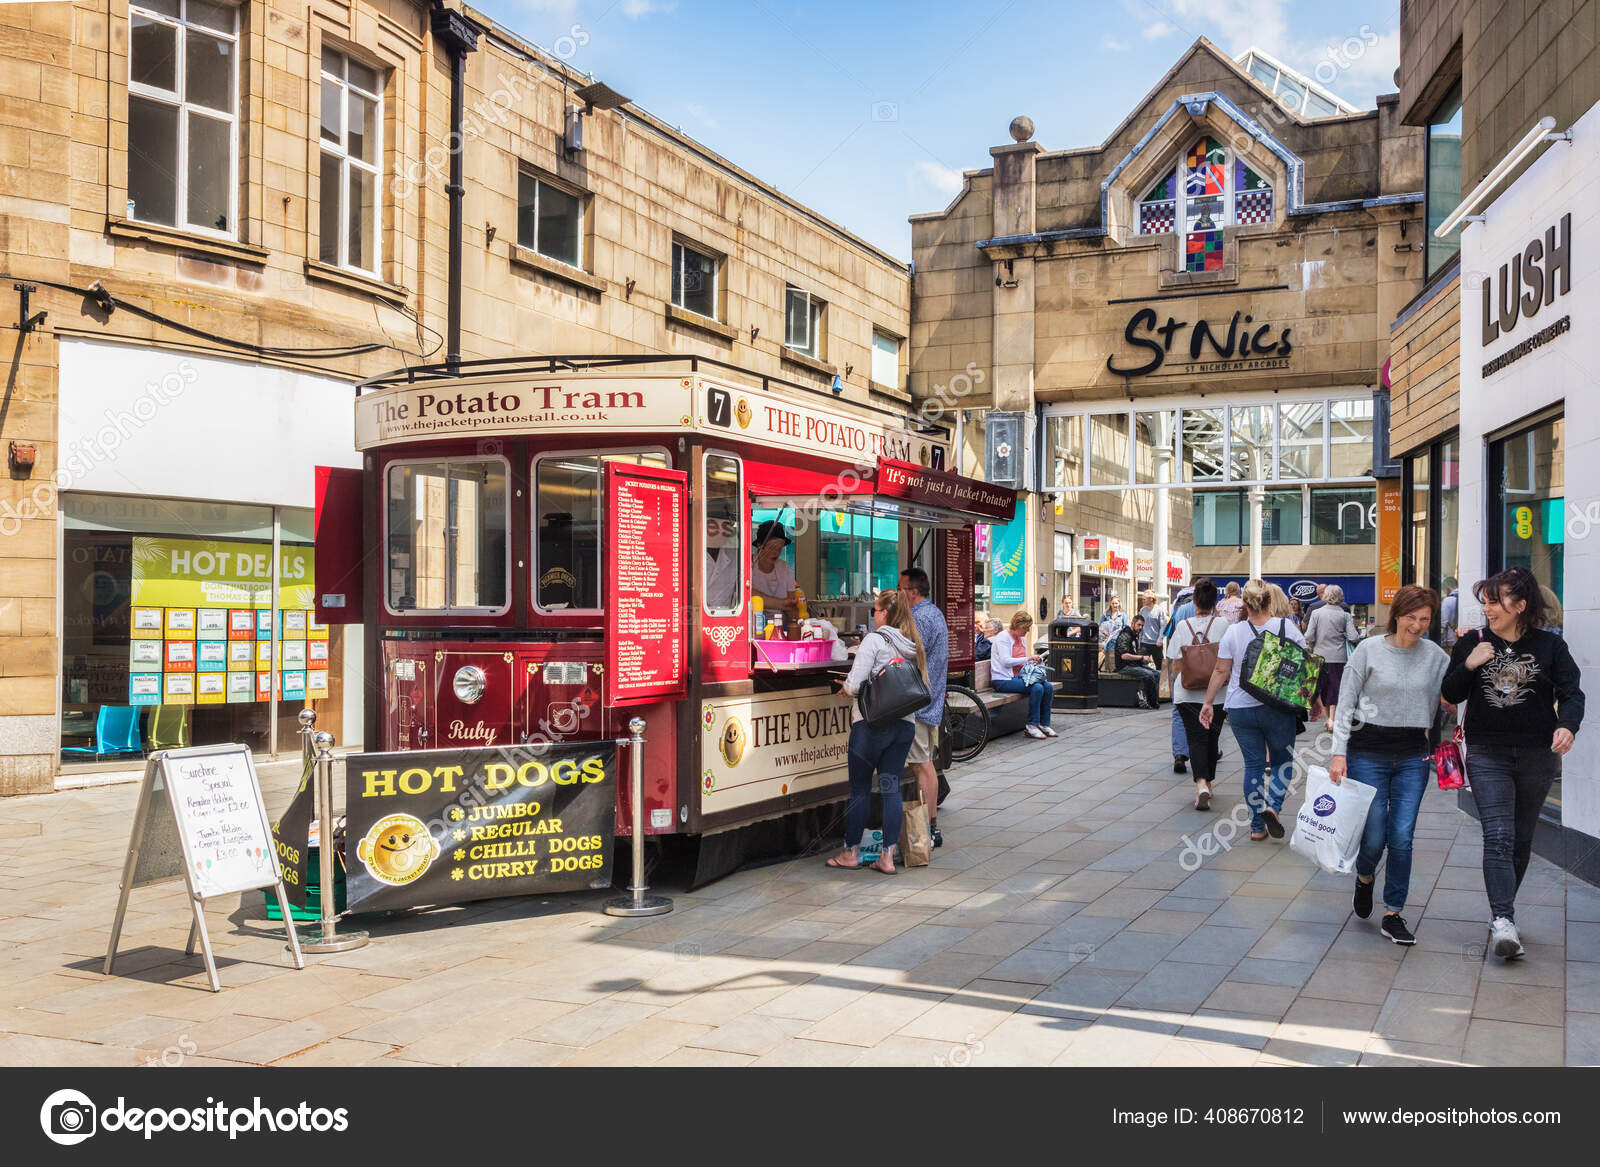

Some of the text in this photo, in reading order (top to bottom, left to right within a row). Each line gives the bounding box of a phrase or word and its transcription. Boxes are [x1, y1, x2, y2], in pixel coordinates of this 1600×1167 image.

[1482, 212, 1571, 347] LUSH
[1107, 308, 1291, 376] St Nics
[1185, 359, 1290, 373] ST NICHOLAS ARCADES
[373, 386, 647, 425] The Potato Tram
[713, 392, 726, 422] 7
[386, 412, 608, 433] www.thejacketpotatostall.co.uk
[764, 406, 912, 462] THE POTATO TRAM
[907, 473, 924, 488] not
[925, 477, 944, 495] just
[946, 485, 951, 494] a
[953, 484, 979, 501] Jacket
[171, 550, 230, 575] HOT
[448, 719, 497, 747] Ruby
[751, 703, 852, 748] THE POTAT
[362, 759, 605, 797] HOT DOGS
[468, 802, 540, 823] JUMBO
[470, 818, 563, 841] REGULAR
[1318, 822, 1336, 835] good
[470, 835, 602, 860] CHILLI DOGS
[279, 863, 299, 886] OGS
[468, 854, 603, 881] CURRY DOGS
